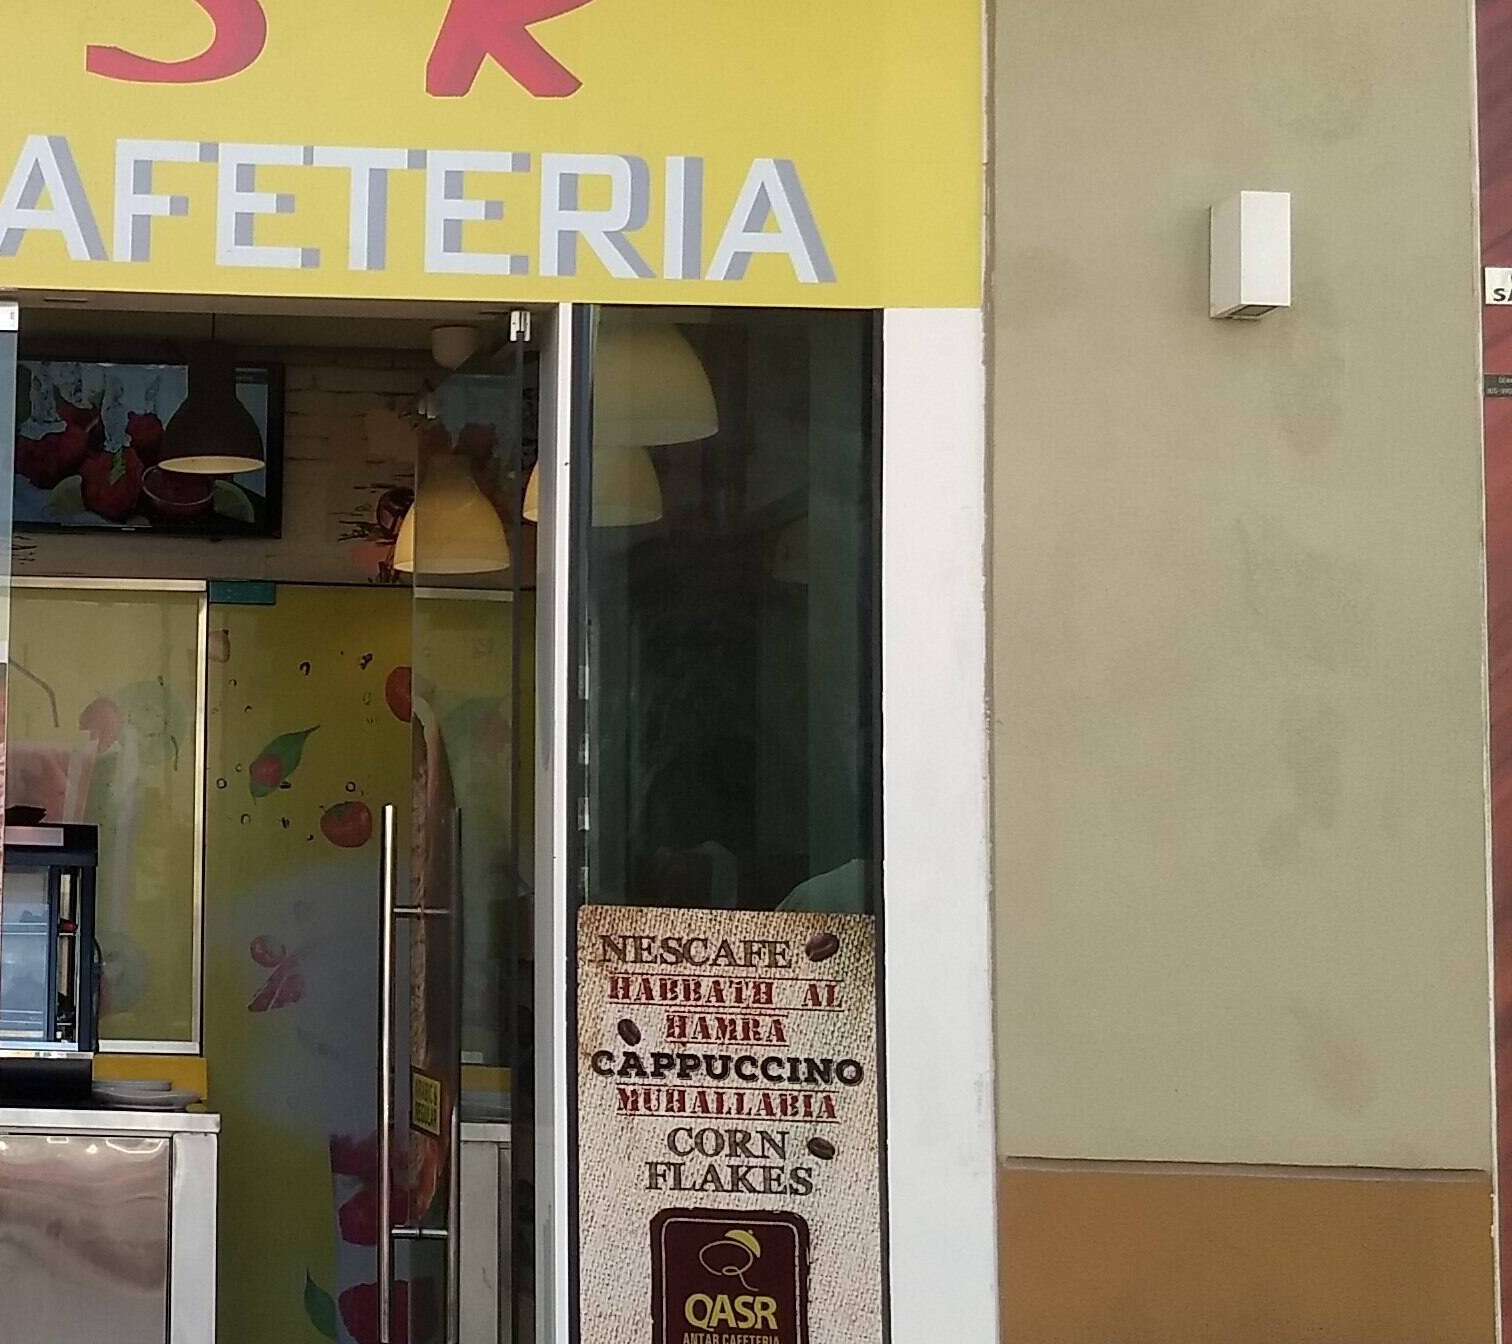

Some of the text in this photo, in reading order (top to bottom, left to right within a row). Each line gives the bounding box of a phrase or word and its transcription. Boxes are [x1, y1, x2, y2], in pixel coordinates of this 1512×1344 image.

[598, 935, 792, 968] NESCAFE
[608, 975, 842, 1007] HABBATH AL
[666, 1014, 786, 1042] HAMRA
[590, 1050, 864, 1086] CAPPUCCINO
[617, 1088, 837, 1119] MUHALLABIA
[666, 1127, 789, 1160] CORN
[645, 1162, 813, 1195] FLAKES
[685, 1293, 778, 1332] QASR
